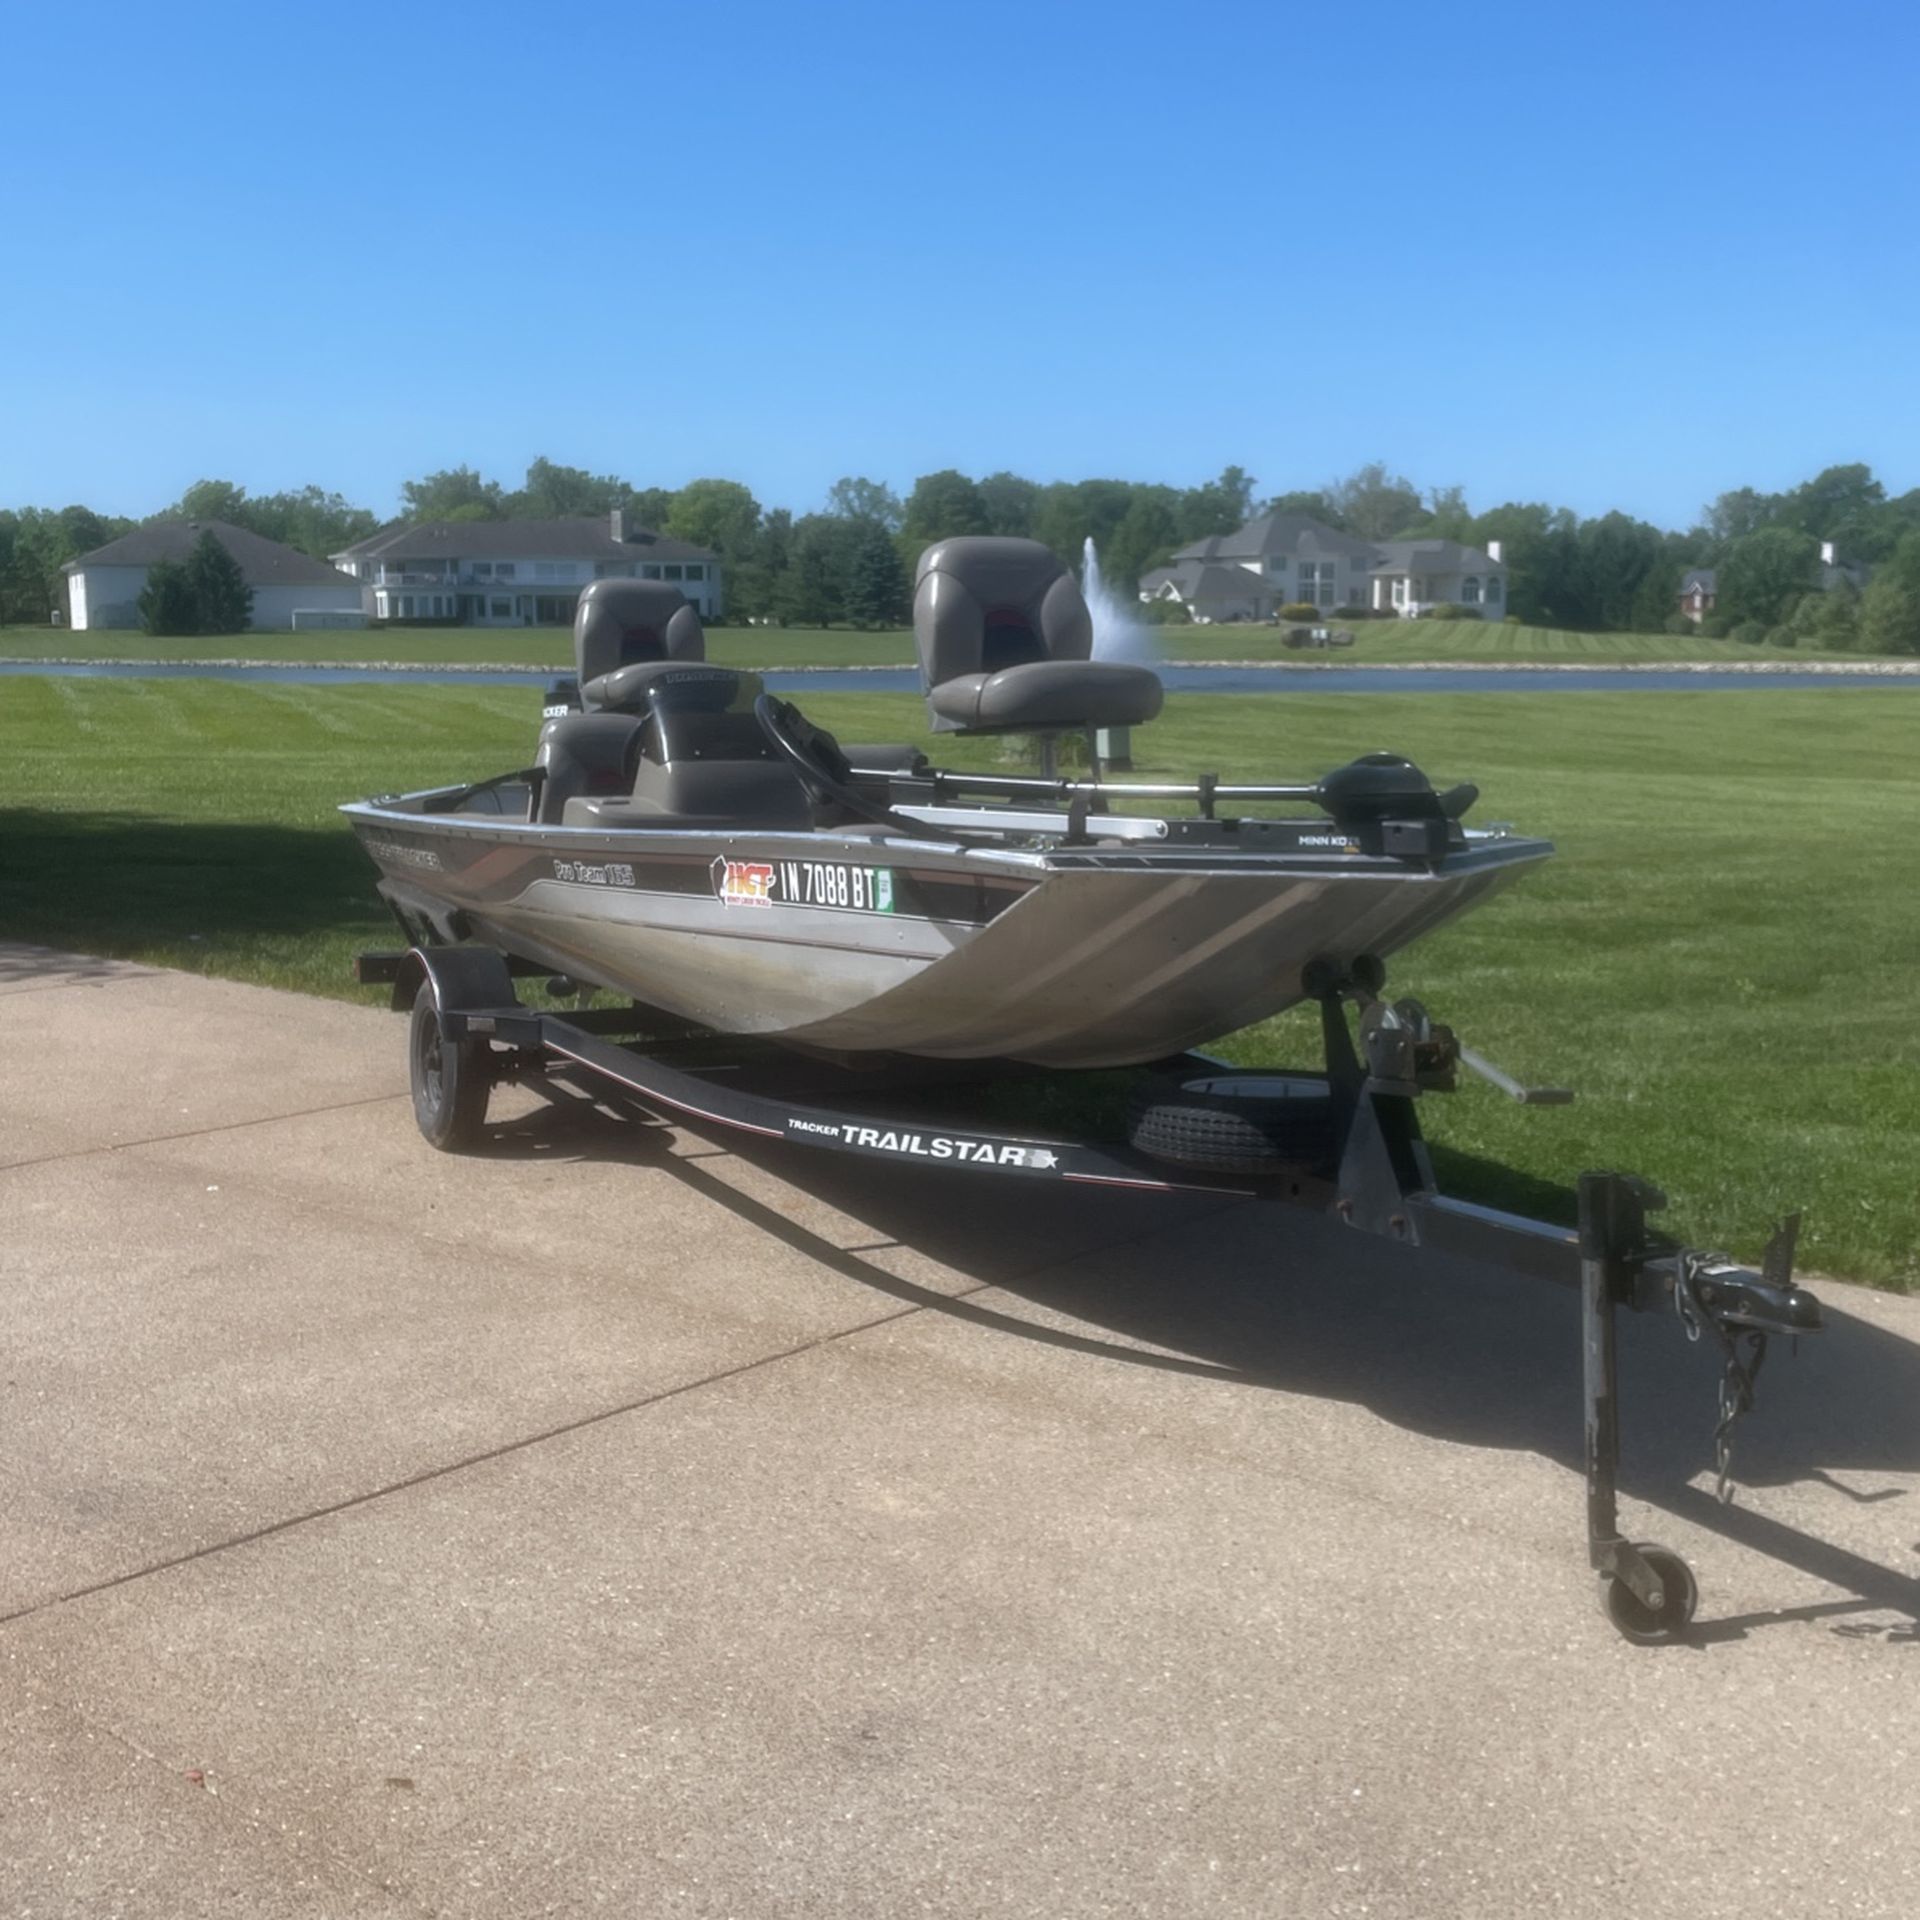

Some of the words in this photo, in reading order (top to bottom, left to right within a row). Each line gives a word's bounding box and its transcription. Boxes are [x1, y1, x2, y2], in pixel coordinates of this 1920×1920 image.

[553, 859, 575, 881] Pro
[573, 861, 607, 884] Team
[780, 862, 800, 902] IN
[803, 863, 848, 907] 7088
[852, 867, 875, 909] BT
[788, 1118, 840, 1138] TRACKER
[842, 1124, 1027, 1167] TRAILSTAR
